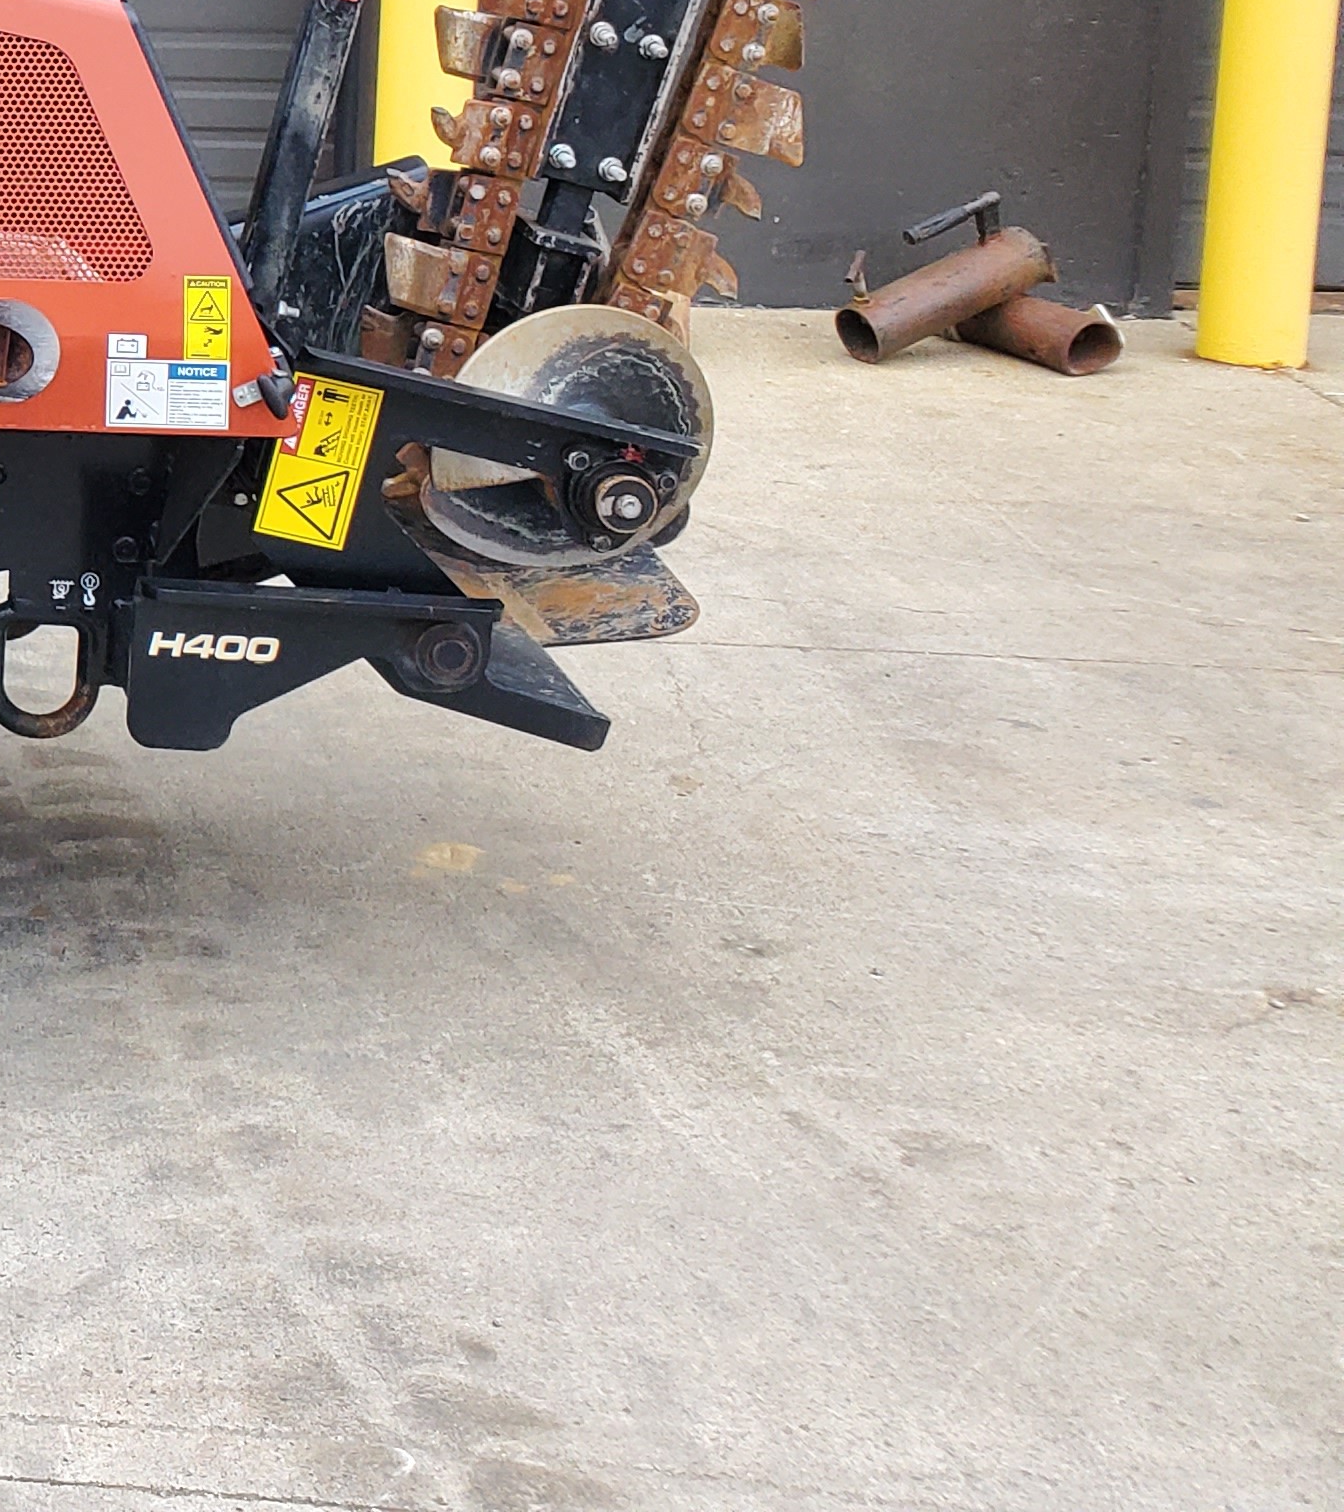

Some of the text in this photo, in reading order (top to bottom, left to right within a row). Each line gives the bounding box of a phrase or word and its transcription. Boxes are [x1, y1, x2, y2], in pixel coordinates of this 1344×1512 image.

[196, 280, 226, 288] CAUTION
[177, 366, 218, 377] NOTICE
[148, 631, 281, 664] H400
